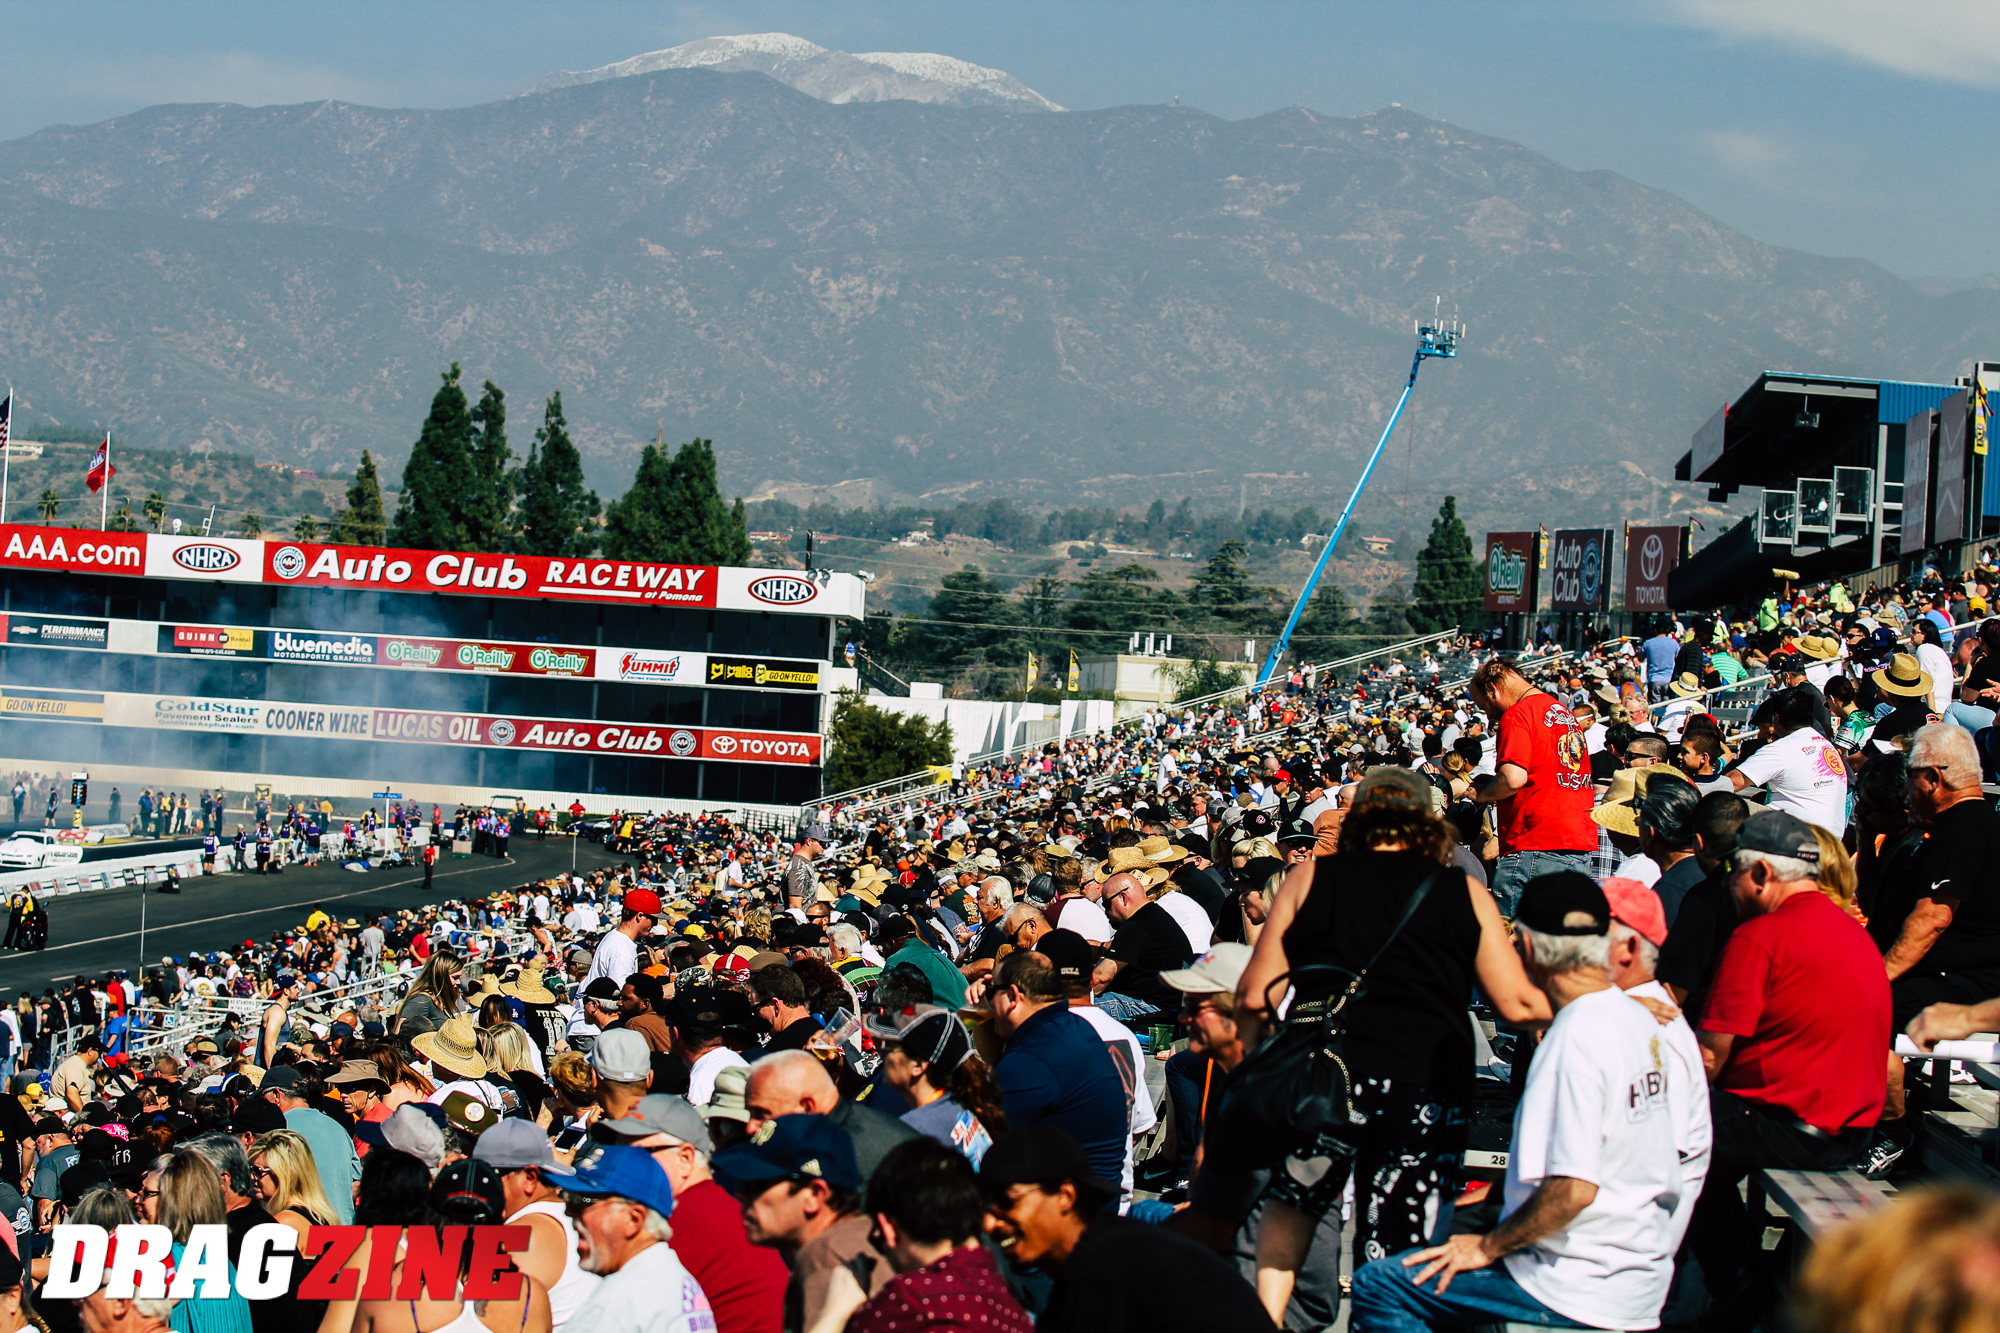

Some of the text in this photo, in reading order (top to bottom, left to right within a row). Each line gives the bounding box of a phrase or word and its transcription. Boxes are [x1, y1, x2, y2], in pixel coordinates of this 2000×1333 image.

[4, 533, 140, 567] AAA.com
[181, 547, 233, 568] NHRA
[1555, 538, 1582, 569] Auto
[306, 548, 413, 583] Auto
[425, 554, 528, 590] Club
[545, 561, 706, 591] RACEWAY
[644, 591, 704, 602] at Pomona
[757, 580, 810, 600] NHRA
[1554, 571, 1580, 602] Club
[1635, 586, 1665, 603] TOYOTA
[41, 624, 106, 637] PERFORMANCE
[178, 631, 215, 642] QUINN
[274, 632, 373, 656] bluemedia
[388, 642, 441, 665] O'Reilly
[273, 652, 372, 662] MOTORSPORTS GRAPHICS
[460, 646, 513, 668] O'Reilly
[532, 650, 587, 673] O'Reilly
[6, 699, 67, 714] GO ON YELLO!
[155, 700, 259, 716] GoldStar
[155, 711, 259, 724] Pavement Sealers
[266, 709, 369, 734] COONER WIRE
[375, 712, 482, 741] LUCAS OIL
[521, 724, 663, 751] Auto Club
[739, 739, 810, 757] TOYOTA
[1491, 1155, 1506, 1166] 28
